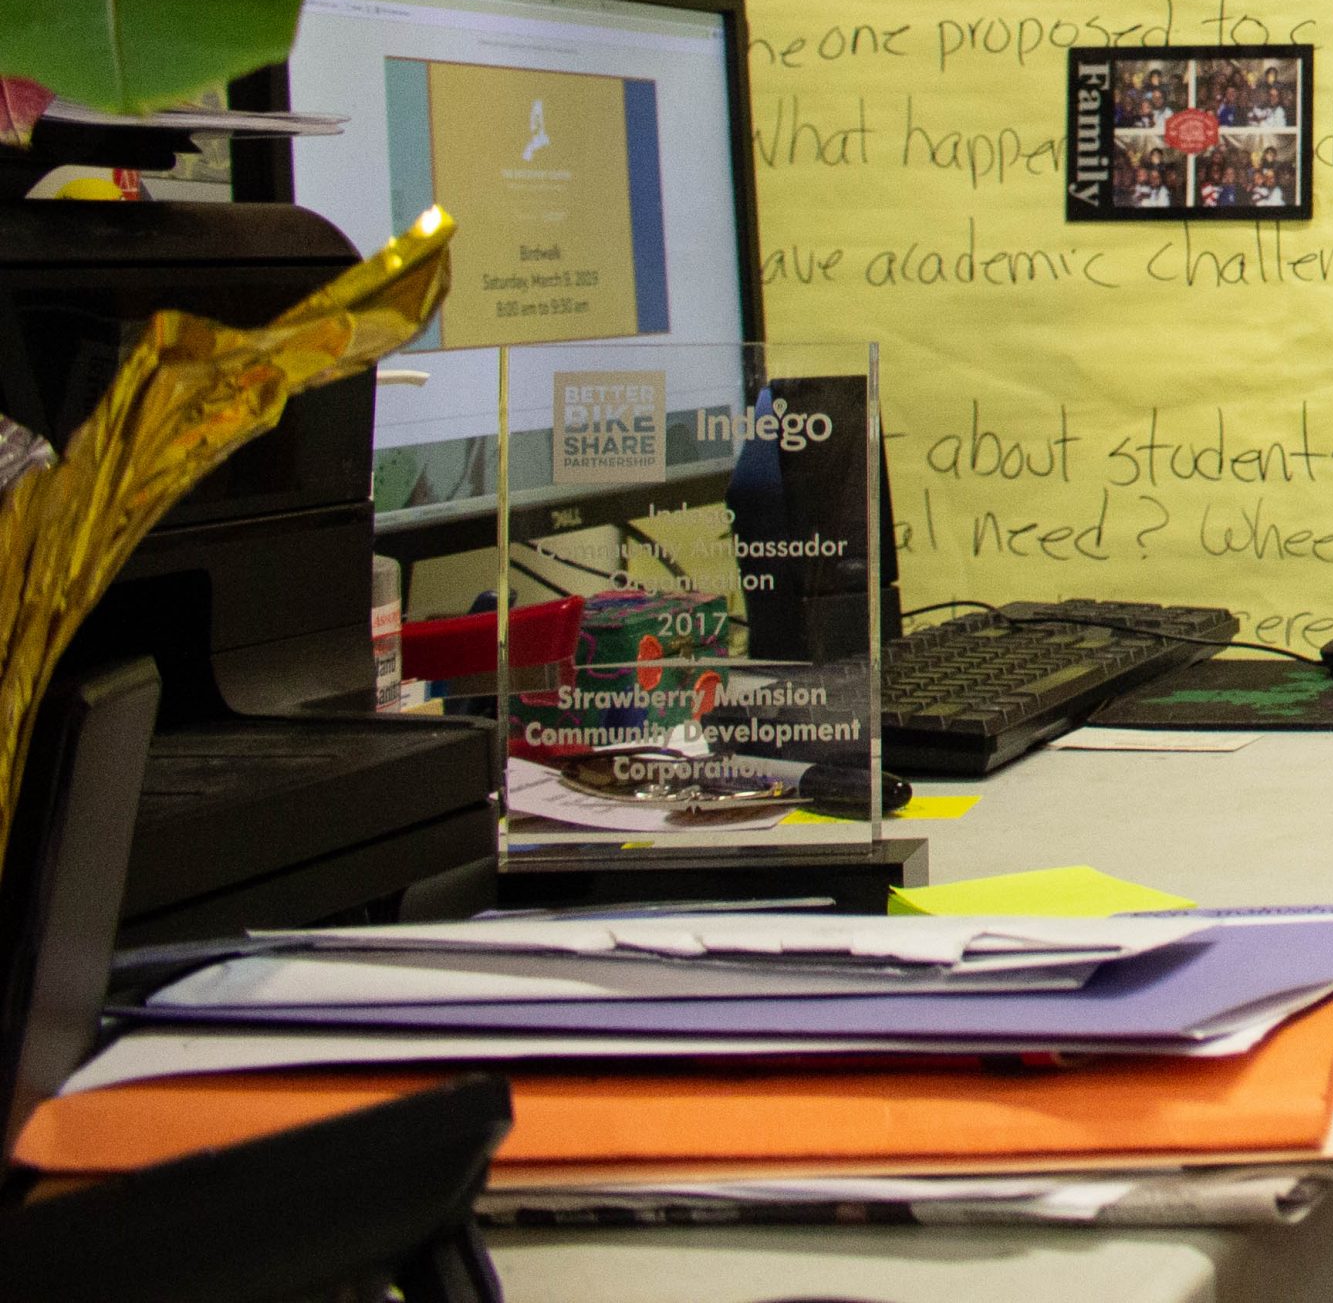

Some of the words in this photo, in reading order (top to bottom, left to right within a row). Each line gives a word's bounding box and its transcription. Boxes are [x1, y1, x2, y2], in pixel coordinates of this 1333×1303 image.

[1069, 62, 1110, 207] Family
[865, 216, 1121, 288] academic
[563, 384, 656, 405] BETTER
[563, 405, 656, 434] BIKE
[563, 436, 656, 456] SHARE
[926, 399, 1081, 482] about
[563, 457, 656, 469] PARTNERSHIP
[657, 612, 728, 636] 2017
[557, 683, 705, 713] Strawberry
[713, 682, 827, 707] Mansion
[525, 720, 678, 748] Community
[684, 718, 861, 748] Development
[612, 755, 776, 783] Corporation
